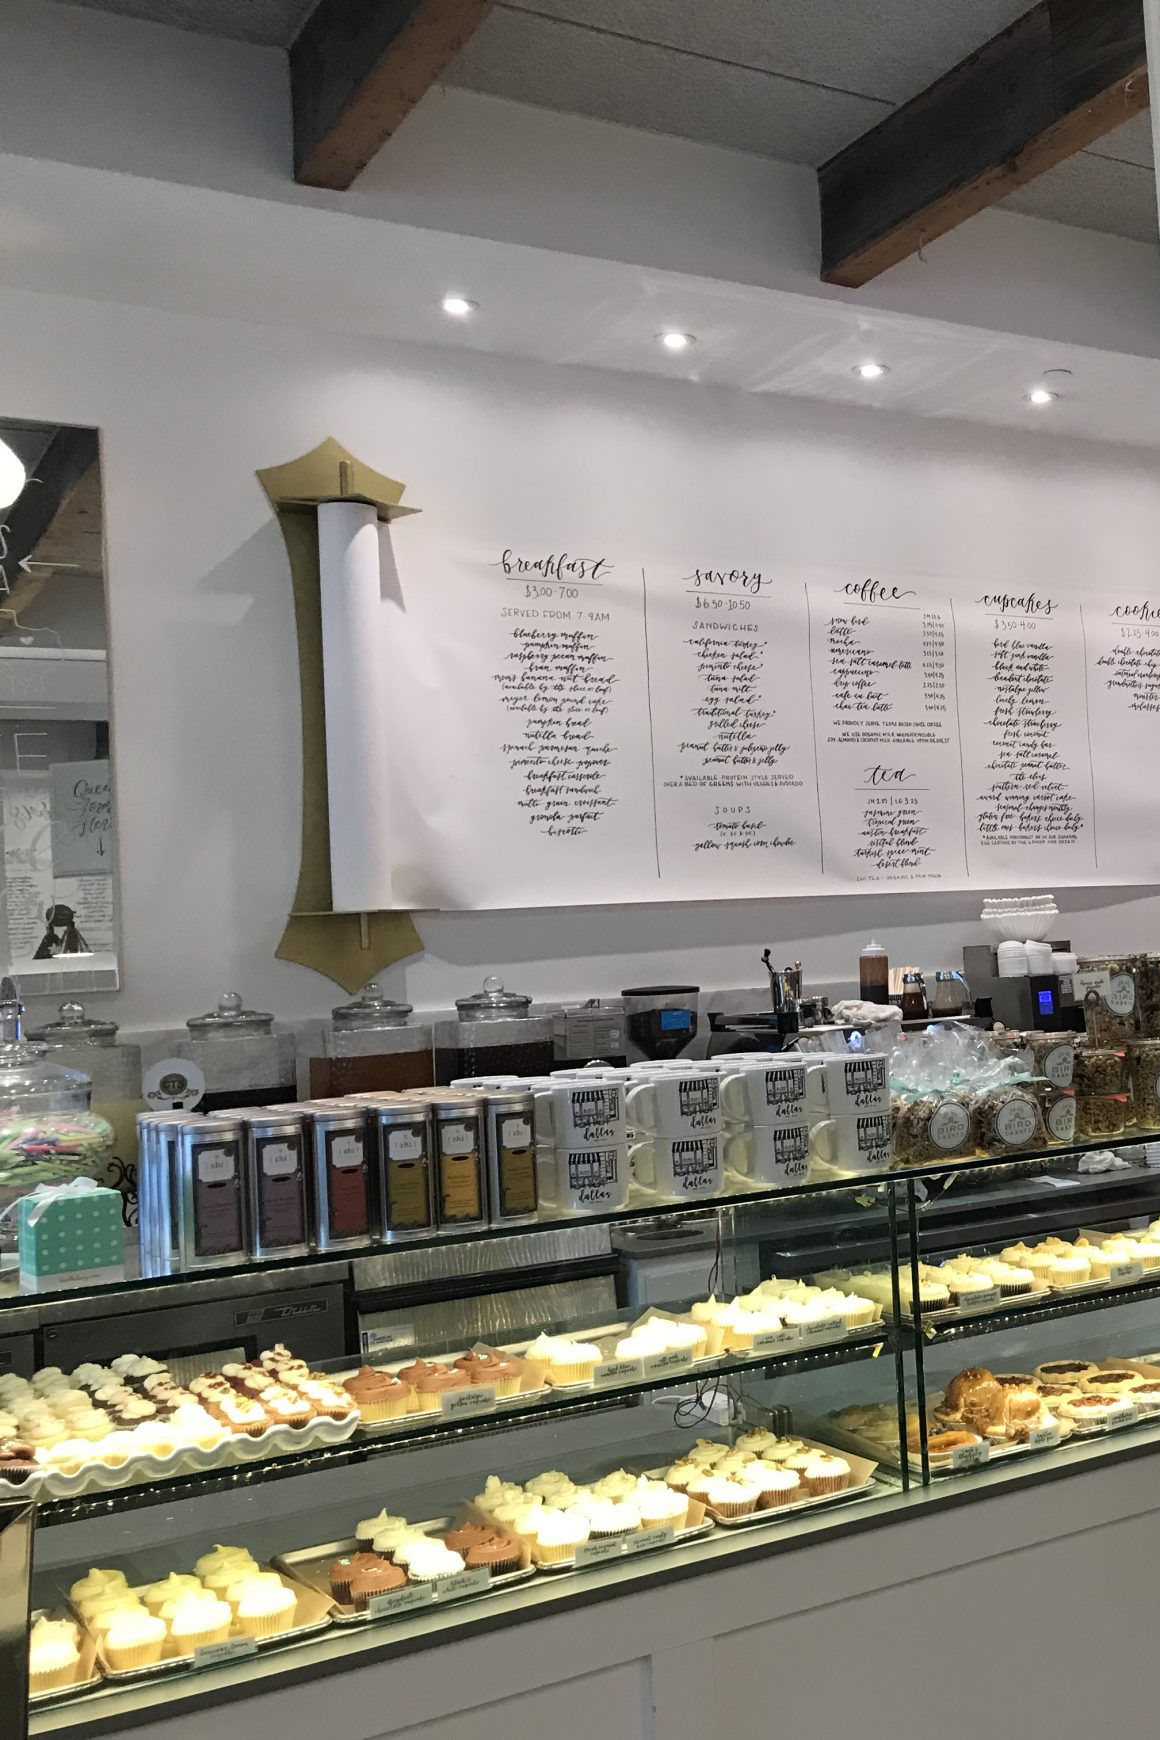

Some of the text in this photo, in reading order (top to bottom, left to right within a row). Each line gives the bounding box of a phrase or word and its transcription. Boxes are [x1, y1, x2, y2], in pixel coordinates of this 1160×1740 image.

[488, 549, 615, 580] breakfast
[681, 569, 772, 594] savory
[833, 578, 917, 603] coffee
[974, 592, 1059, 615] cupcakes
[501, 607, 539, 617] SERVED
[543, 611, 571, 620] FROM
[692, 621, 759, 632] SANDWICHES
[828, 626, 857, 635] latte
[509, 628, 598, 643] blueberry muffin
[827, 637, 861, 646] mocha
[521, 642, 595, 652] pumpkin muffin
[504, 651, 614, 664] raspberry pecan muffin
[554, 664, 594, 674] muffin
[520, 672, 554, 682] banana
[582, 674, 620, 684] bread
[731, 674, 761, 682] salad
[701, 696, 720, 705] egg
[526, 718, 592, 728] pumpkin bread
[739, 720, 766, 729] cheese
[523, 730, 594, 740] nutella bread
[713, 731, 756, 741] nutella
[524, 770, 574, 782] breakfast
[863, 765, 917, 785] tea
[523, 785, 567, 796] breakfast
[855, 1094, 882, 1107] dallas
[776, 1104, 803, 1117] dallas
[690, 1115, 716, 1128] dallas
[1004, 1120, 1032, 1131] BIRD
[584, 1128, 615, 1141] dallas
[937, 1124, 964, 1134] BIRD
[784, 1163, 808, 1175] dallas
[682, 1176, 712, 1189] dallas
[579, 1190, 612, 1203] dallas
